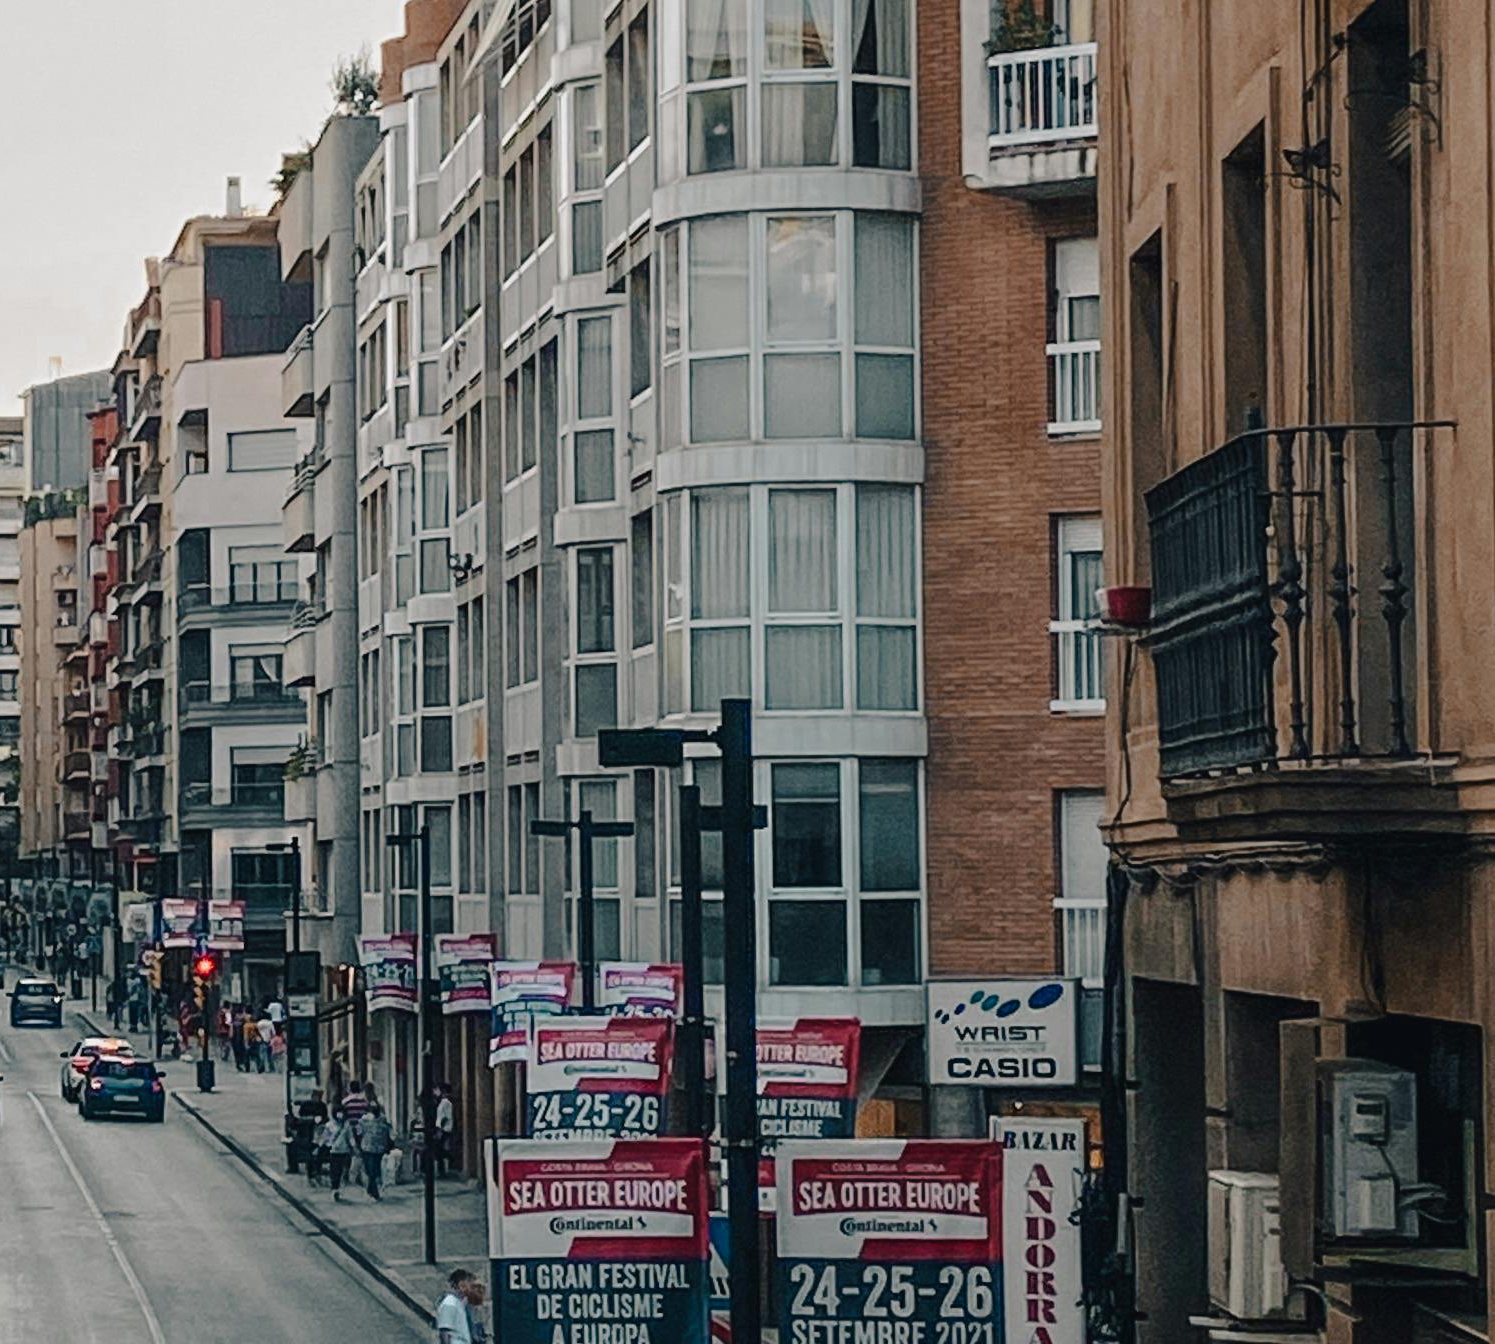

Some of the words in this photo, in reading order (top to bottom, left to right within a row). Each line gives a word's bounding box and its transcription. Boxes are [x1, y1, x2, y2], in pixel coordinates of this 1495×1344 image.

[955, 1026, 1046, 1040] WRIST
[565, 1042, 605, 1060] OTTER
[947, 1057, 1056, 1078] CASIO
[533, 1093, 659, 1131] 24-25-26
[780, 1100, 842, 1118] FESTIVAL
[1004, 1131, 1076, 1151] BAZAR
[509, 1181, 547, 1211] SEA
[550, 1180, 611, 1208] OTTER
[614, 1179, 688, 1210] EUROPE
[799, 1181, 836, 1211] SEA
[840, 1181, 902, 1208] OTTER
[906, 1181, 981, 1213] EUROPE
[549, 1216, 634, 1235] Continental
[839, 1217, 925, 1236] Continental
[509, 1264, 532, 1290] EL
[536, 1263, 593, 1290] GRAN
[599, 1263, 690, 1288] FESTIVAL
[790, 1263, 993, 1318] 24-25-26
[536, 1294, 563, 1320] DE
[568, 1293, 664, 1319] CICLISME
